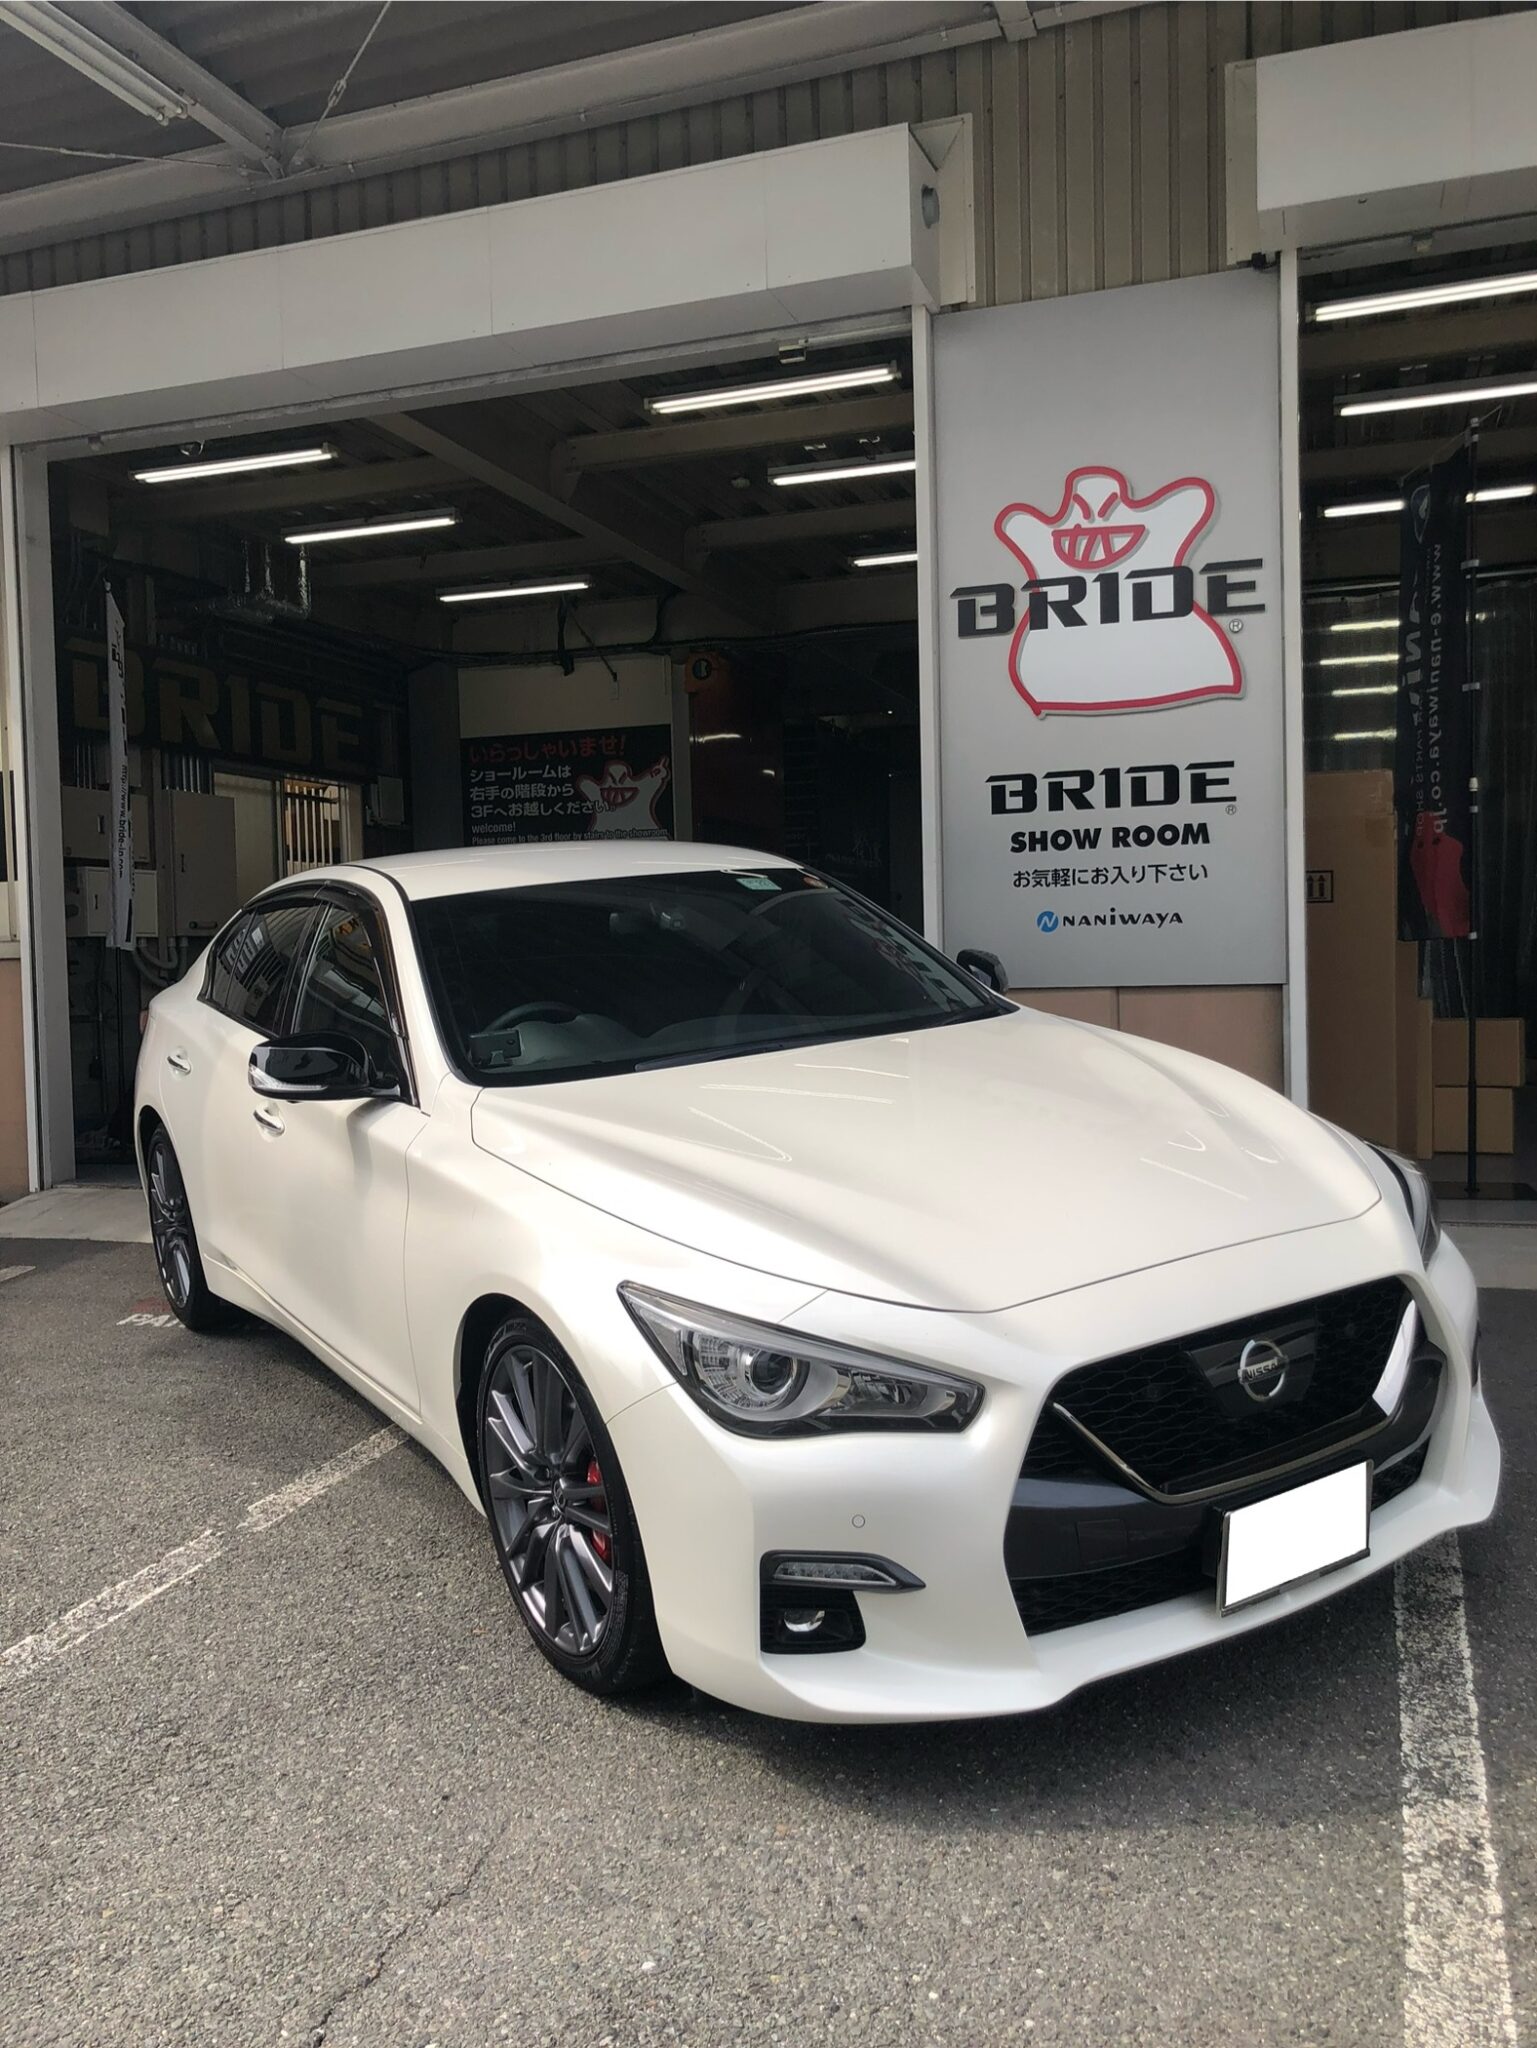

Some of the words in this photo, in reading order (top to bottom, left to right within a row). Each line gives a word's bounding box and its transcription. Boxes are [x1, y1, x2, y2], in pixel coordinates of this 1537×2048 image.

[950, 558, 1265, 639] BRIDE
[64, 637, 363, 771] BRIDE
[469, 764, 572, 783] ショールームは
[469, 782, 575, 801] 右手の階段から
[985, 760, 1237, 815] BRIDE
[471, 800, 616, 819] 3Fへお越しください。
[471, 820, 517, 834] welcome!
[1010, 827, 1102, 853] SHOW
[1112, 822, 1211, 849] ROOM
[1012, 863, 1209, 888] お気軽にお入り下さい
